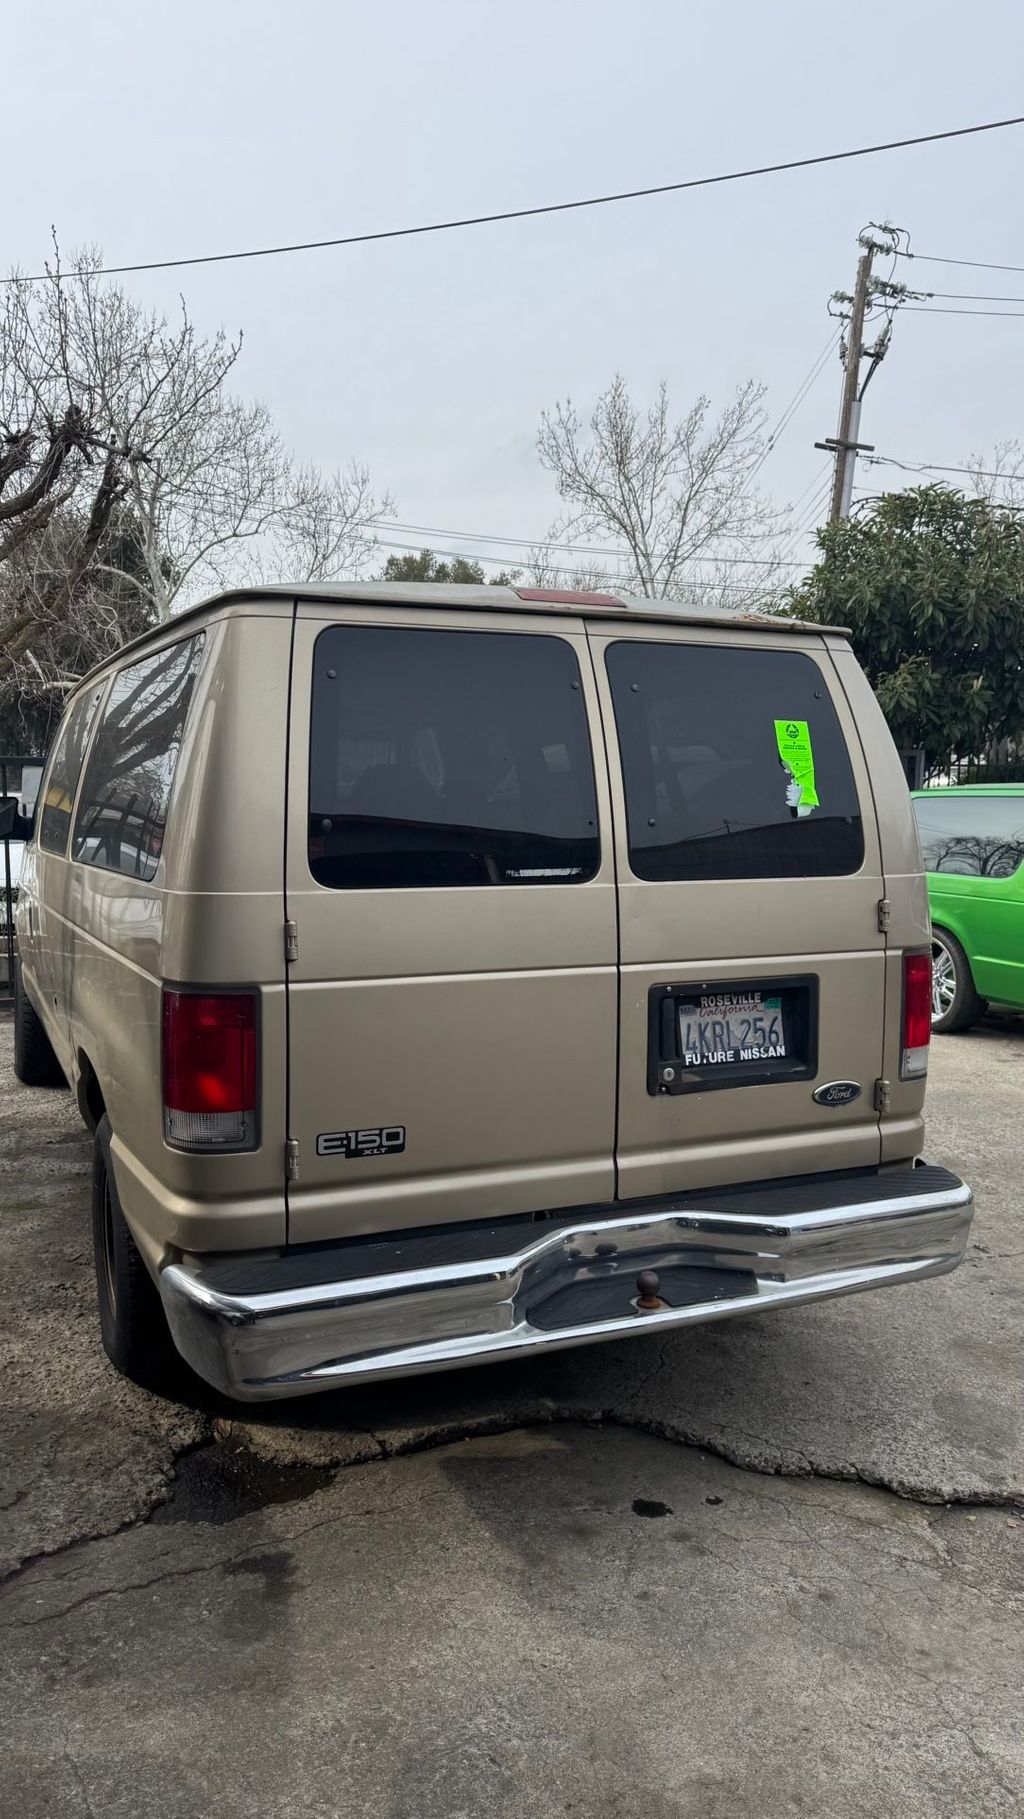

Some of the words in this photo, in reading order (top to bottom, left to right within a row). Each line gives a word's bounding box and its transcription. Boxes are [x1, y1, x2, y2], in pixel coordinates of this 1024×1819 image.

[701, 992, 762, 1008] ROSEVILLE
[700, 1004, 765, 1020] California
[686, 1016, 780, 1051] 4KRL256
[740, 1045, 786, 1061] NISSAN
[827, 1086, 852, 1100] Ford
[363, 1147, 388, 1155] XLT
